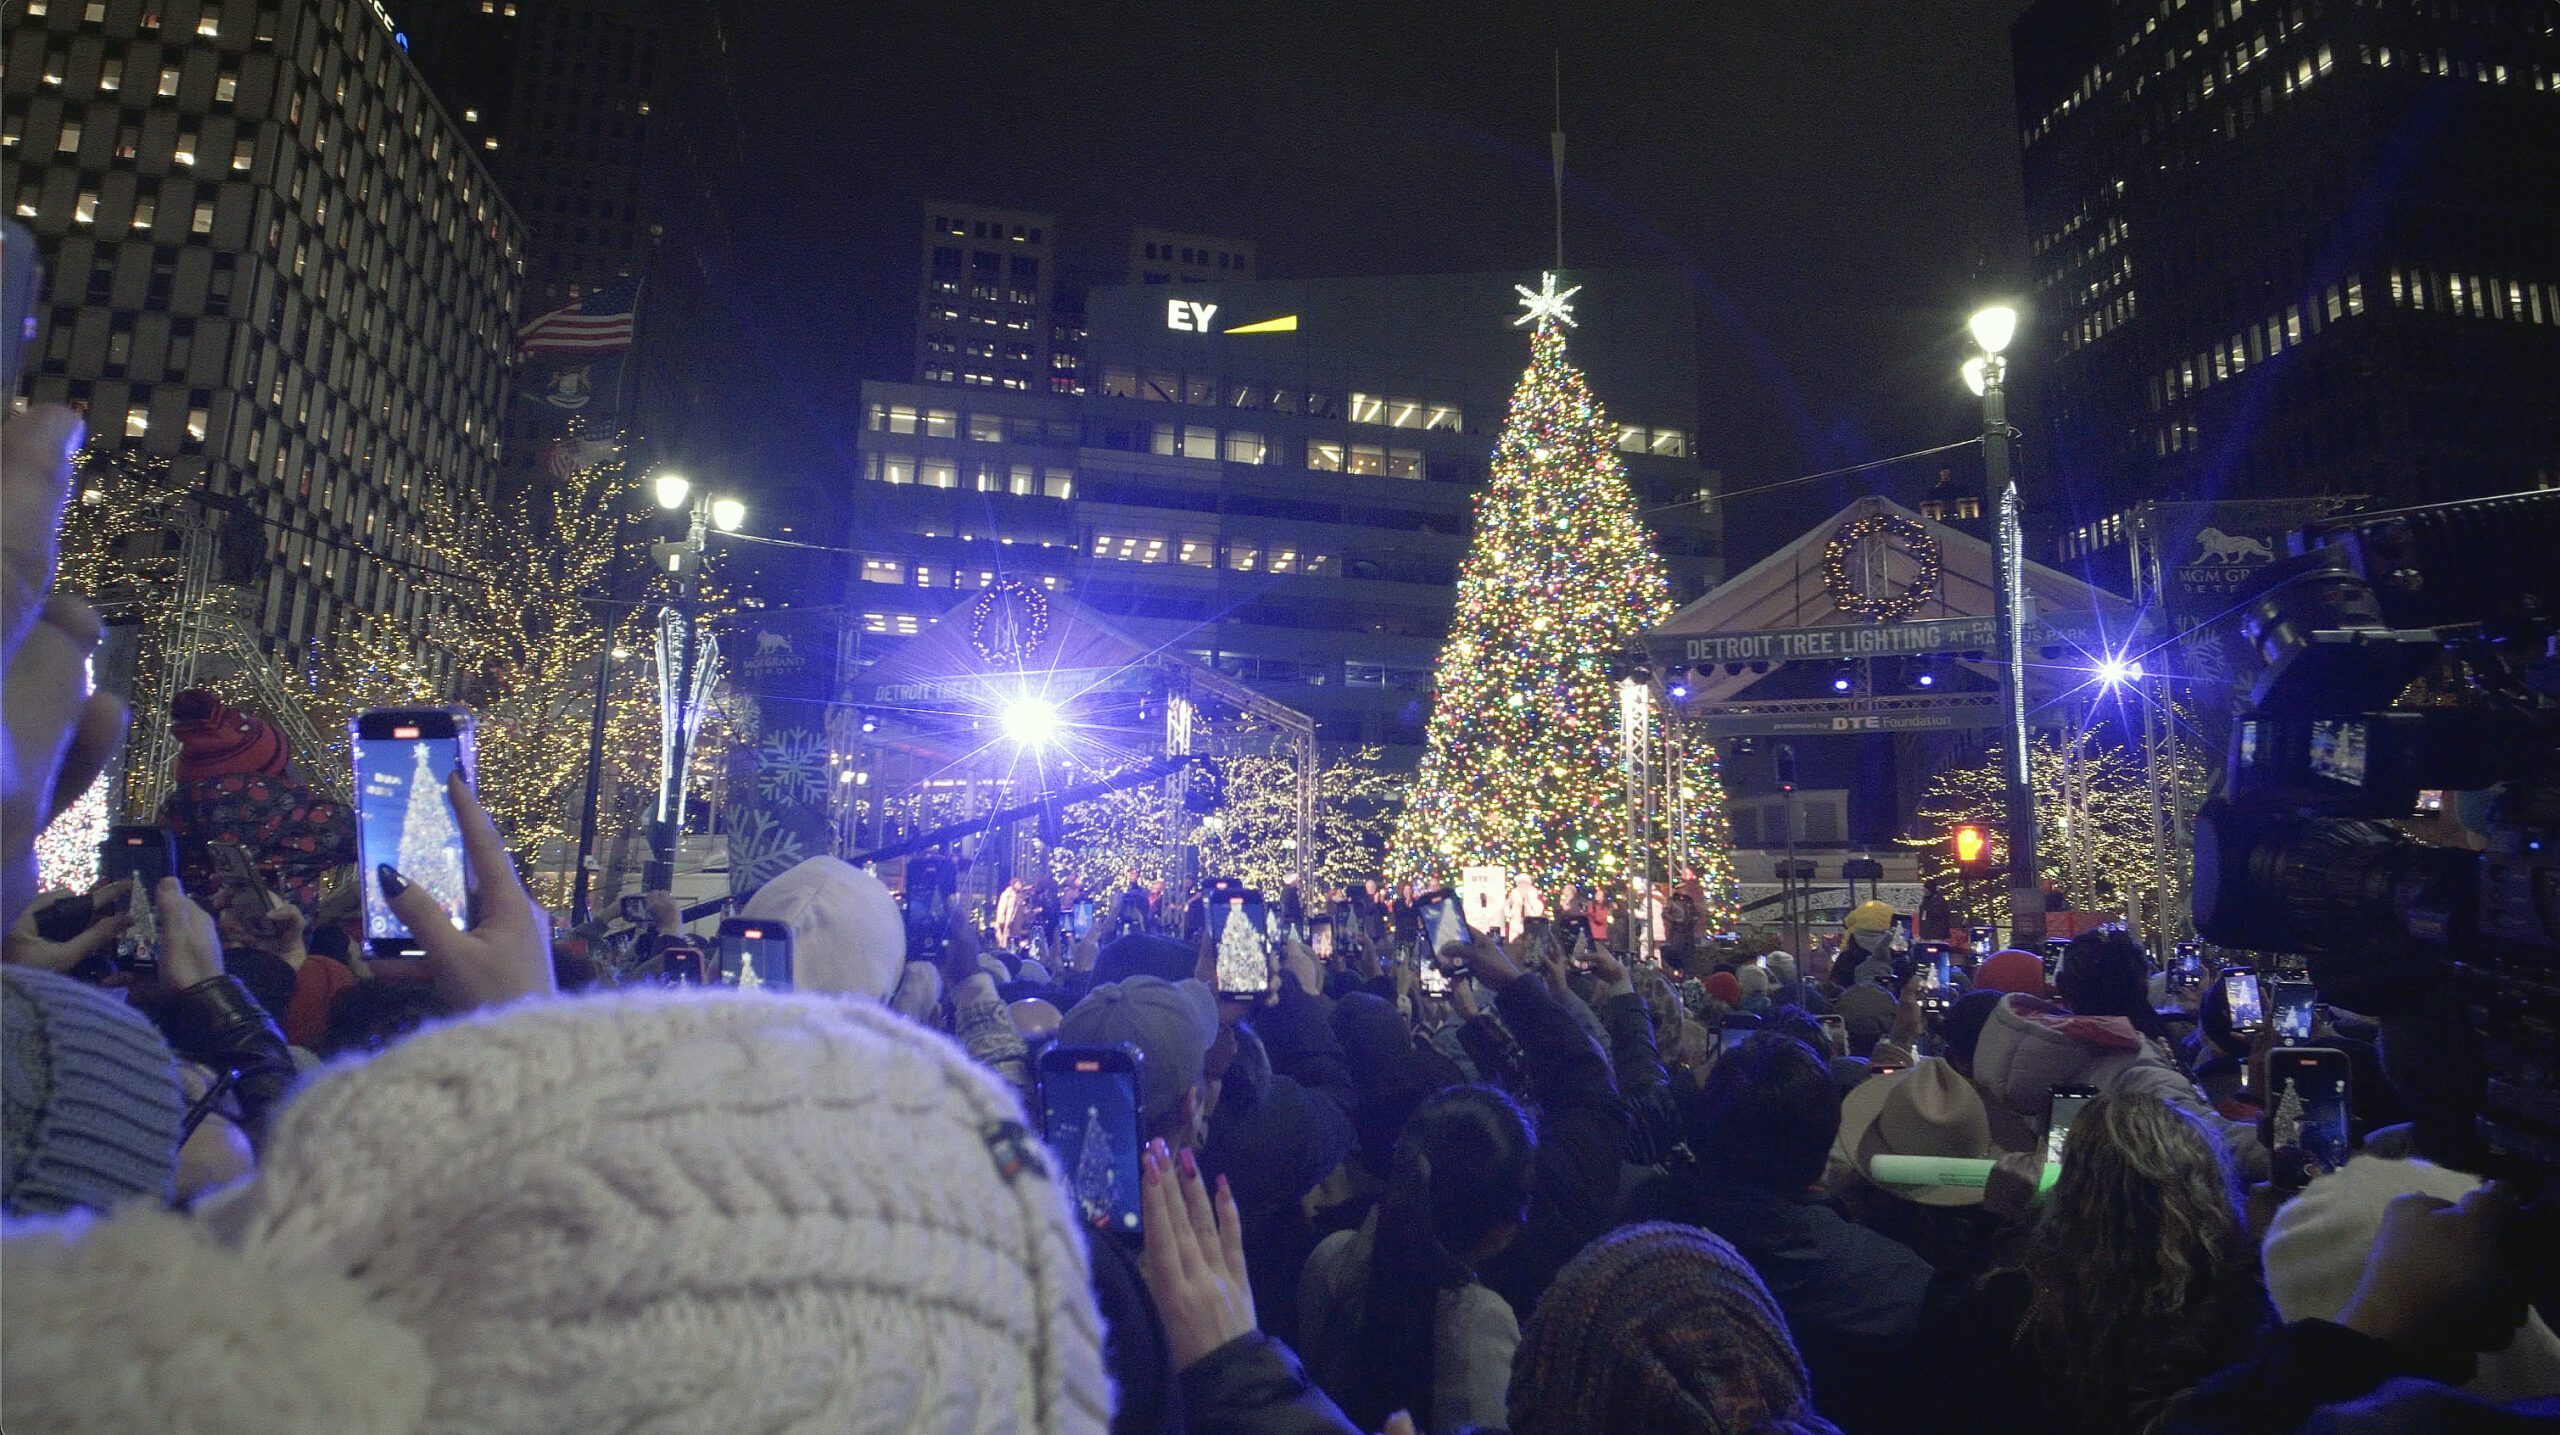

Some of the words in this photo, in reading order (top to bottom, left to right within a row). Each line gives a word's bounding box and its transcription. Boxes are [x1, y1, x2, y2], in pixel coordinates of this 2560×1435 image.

[1168, 299, 1218, 333] EY
[2179, 569, 2221, 583] MGM
[1687, 635, 1773, 660] DETROIT
[1780, 632, 1834, 656] TREE
[1840, 626, 1941, 652] LIGHTING
[1950, 630, 1967, 643] AT
[2046, 628, 2089, 642] PARK
[875, 683, 929, 701] DETROIT
[1832, 715, 1880, 731] DTE
[1882, 714, 1951, 729] Foundation
